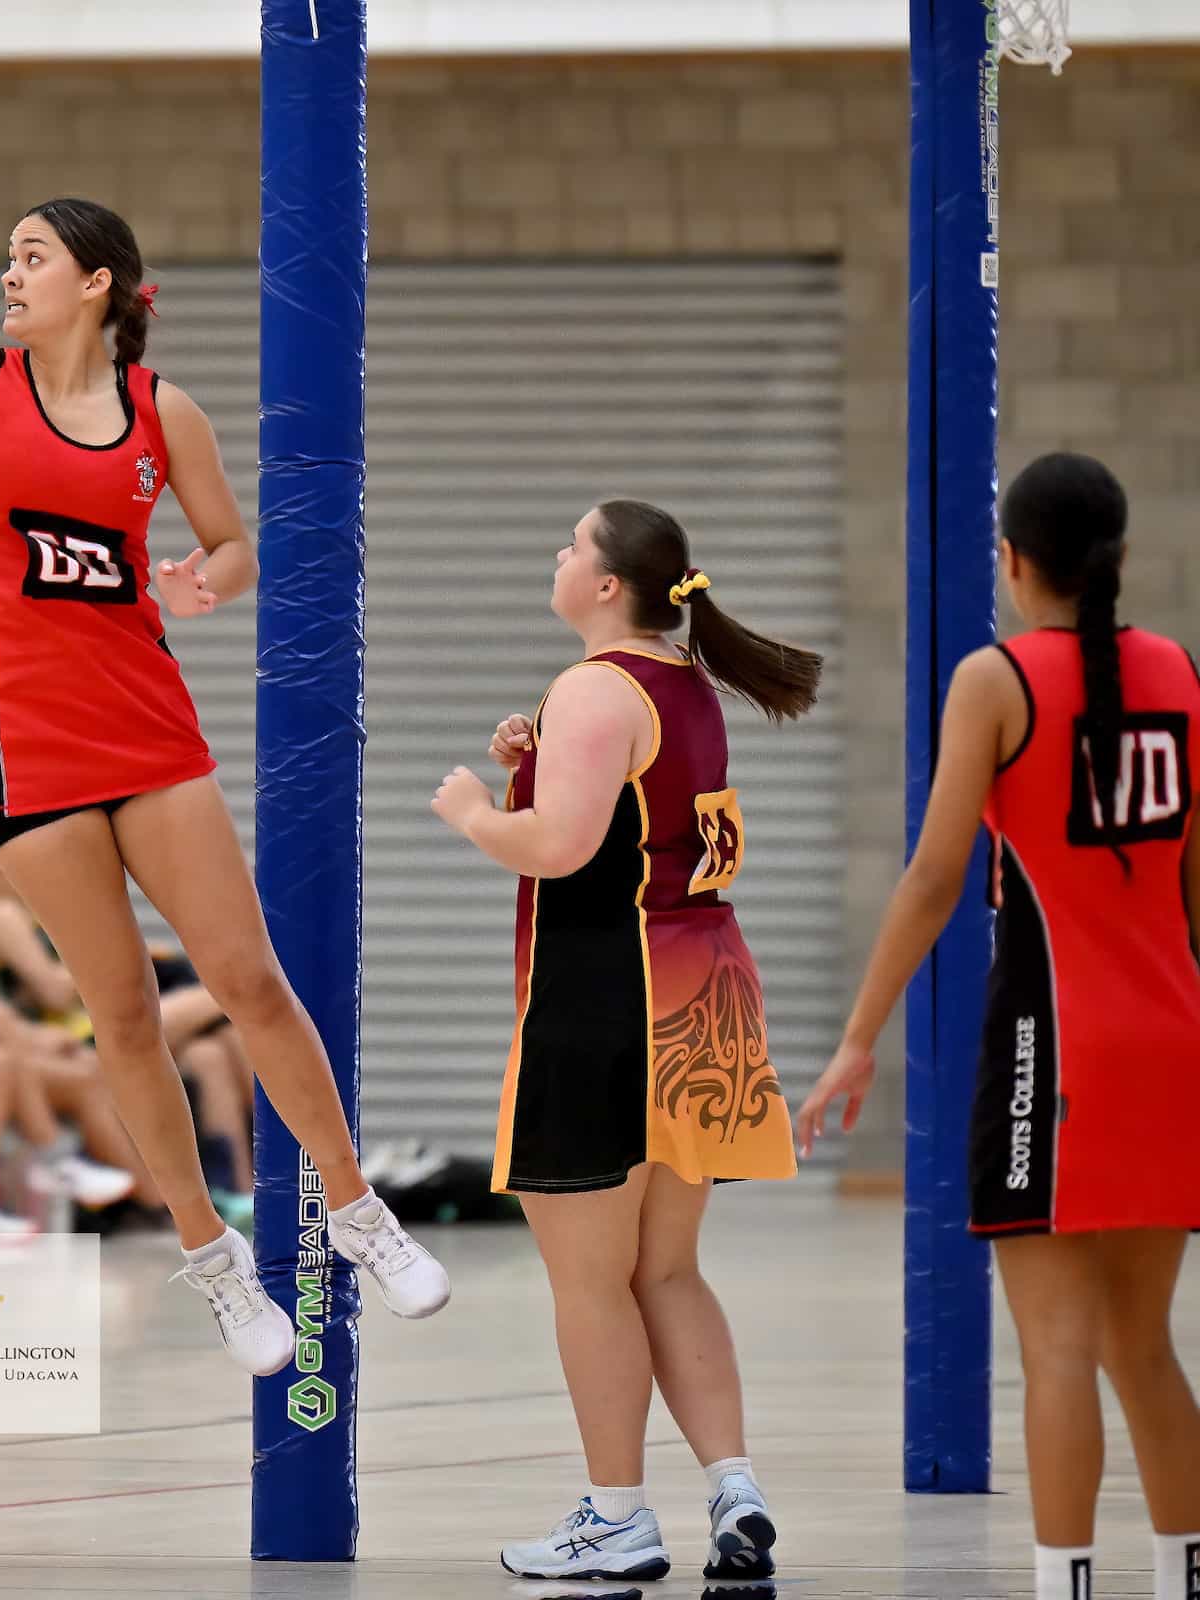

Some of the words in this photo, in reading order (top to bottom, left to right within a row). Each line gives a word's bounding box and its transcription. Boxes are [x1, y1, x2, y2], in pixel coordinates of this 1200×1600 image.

[27, 529, 123, 588] GD
[1009, 1015, 1035, 1118] COLLEGE
[1006, 1119, 1032, 1190] SCOTS
